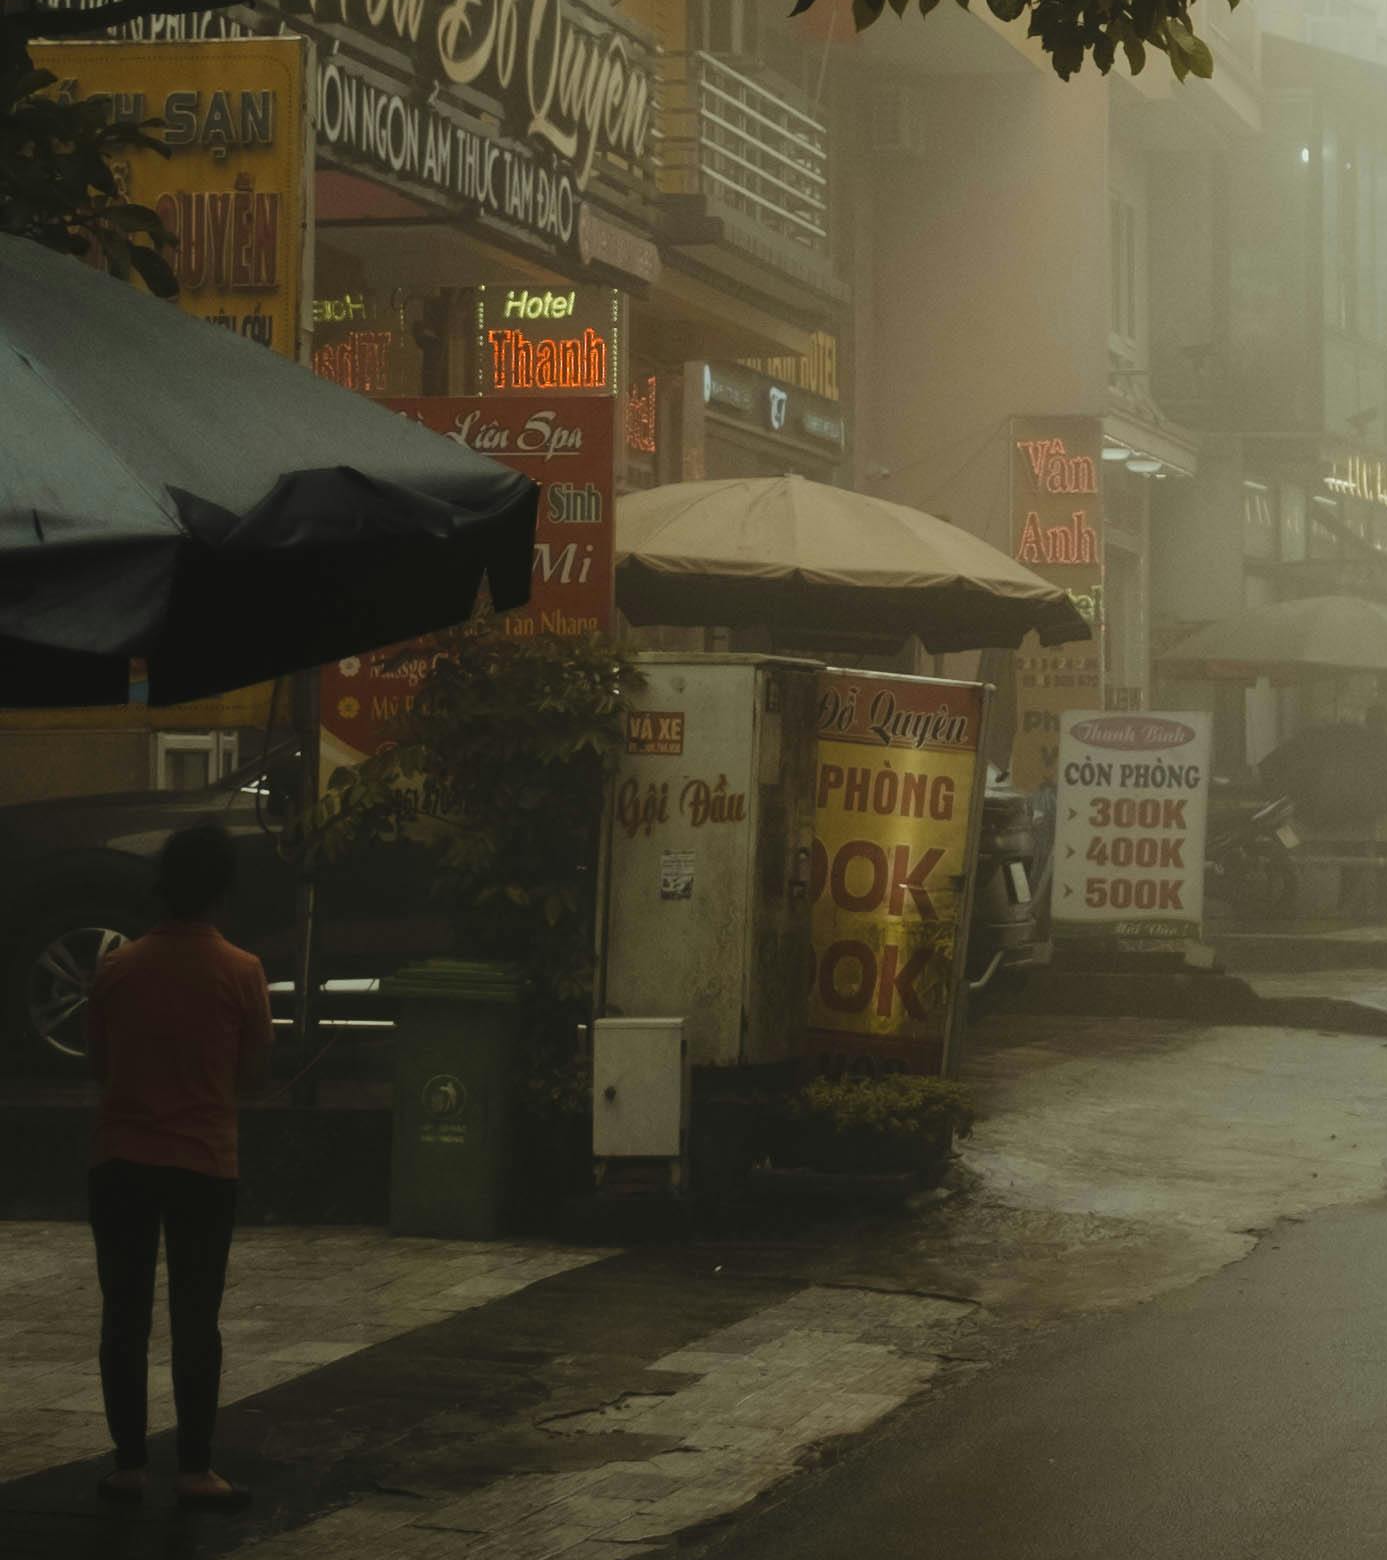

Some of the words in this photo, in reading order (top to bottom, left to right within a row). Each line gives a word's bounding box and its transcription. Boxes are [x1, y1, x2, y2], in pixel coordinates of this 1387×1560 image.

[163, 91, 274, 159] SẠN
[361, 87, 420, 173] NGON
[502, 150, 534, 224] TAM
[504, 291, 576, 320] Hotel
[488, 328, 608, 389] Thanh
[1016, 438, 1098, 495] Vân
[547, 482, 603, 524] Sinh
[1015, 511, 1100, 564] Anh
[657, 717, 682, 741] XE
[816, 760, 956, 822] PHÒNG
[1064, 756, 1114, 787] CÒN
[1119, 758, 1200, 789] PHÒNG
[1088, 797, 1188, 830] 300K
[1085, 836, 1186, 869] 400K
[1085, 877, 1185, 911] 500K
